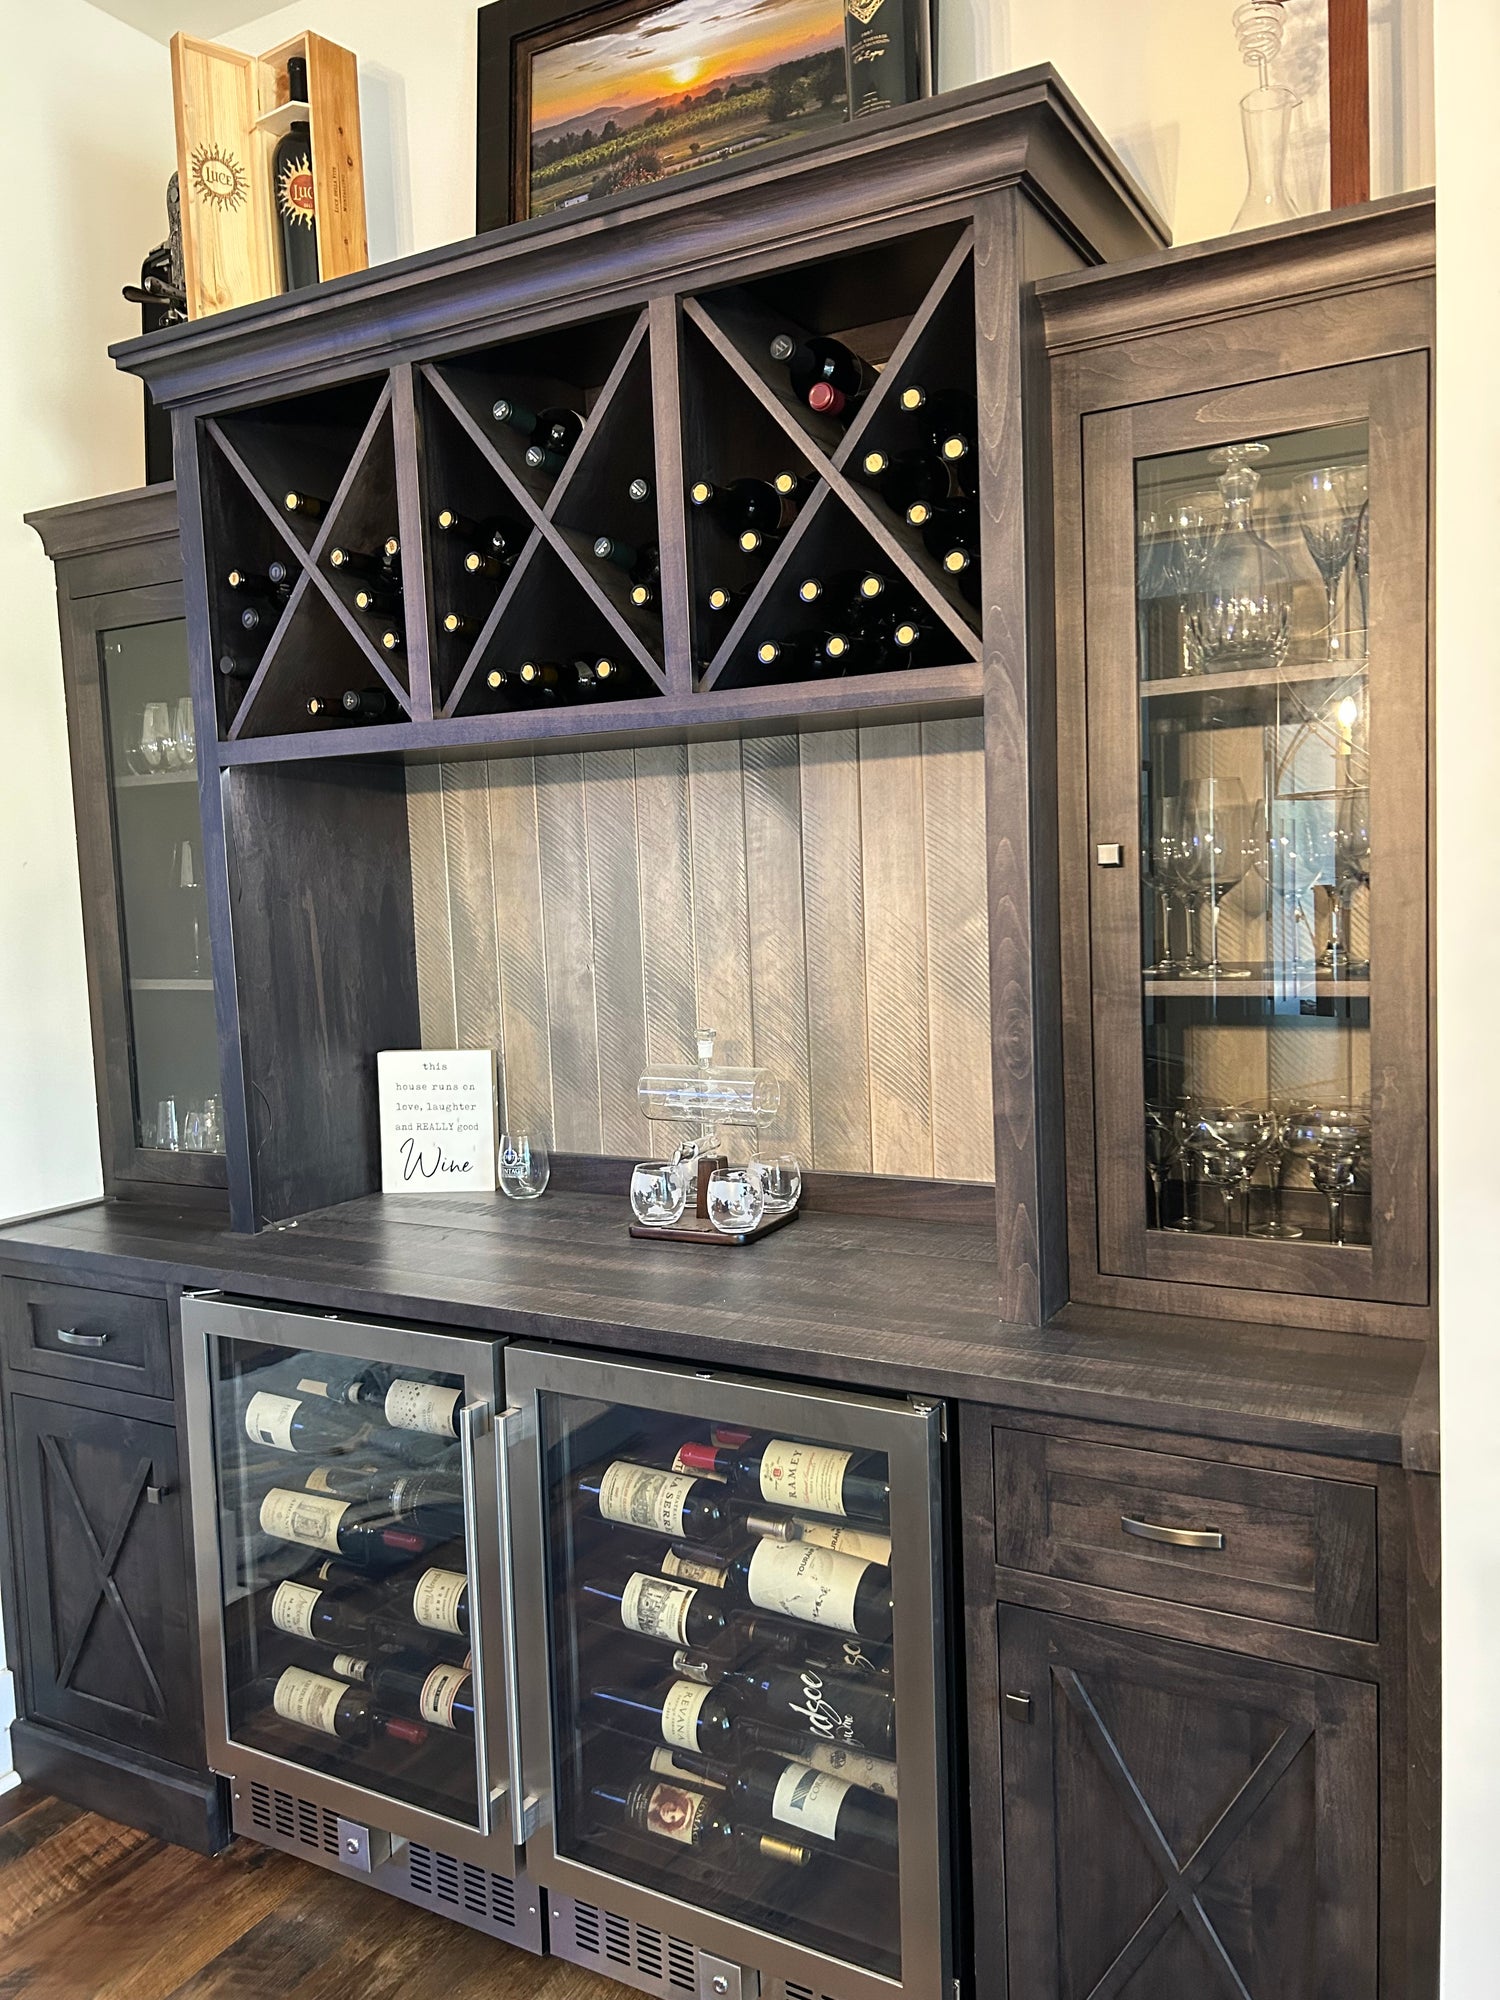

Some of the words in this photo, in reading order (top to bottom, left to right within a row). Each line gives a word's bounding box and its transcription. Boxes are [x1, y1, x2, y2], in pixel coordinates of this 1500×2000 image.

[206, 166, 233, 186] LUCE
[293, 185, 314, 201] LUC
[423, 1062, 448, 1071] this
[395, 1083, 427, 1091] house
[396, 1102, 423, 1112] love,
[426, 1102, 477, 1112] laughter
[395, 1122, 413, 1131] and
[416, 1122, 454, 1131] REALLY
[456, 1122, 479, 1132] good
[400, 1138, 473, 1180] Wine
[670, 1475, 683, 1488] LA
[788, 1450, 803, 1498] RAMEY
[663, 1492, 674, 1533] SERRE
[677, 1691, 694, 1741] REVANA
